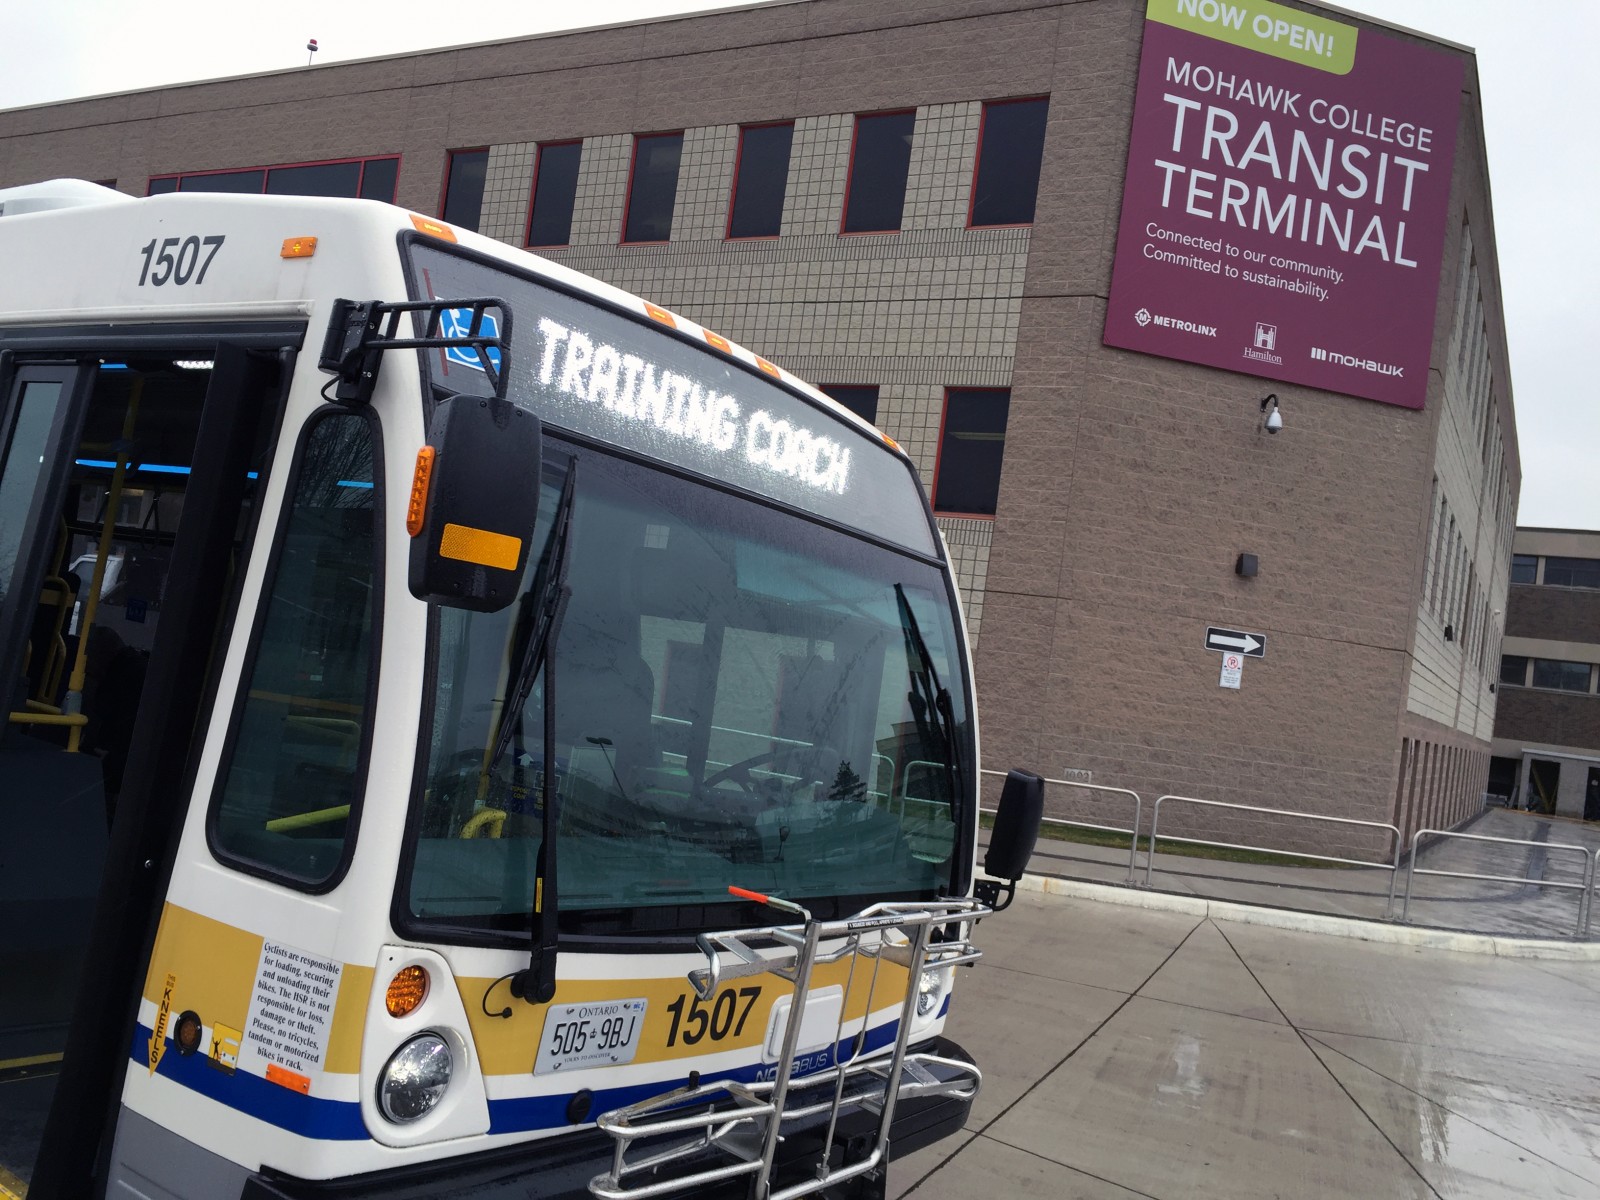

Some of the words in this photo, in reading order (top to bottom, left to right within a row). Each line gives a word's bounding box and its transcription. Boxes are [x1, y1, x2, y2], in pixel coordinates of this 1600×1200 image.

[1177, 0, 1247, 30] NOW
[1252, 15, 1334, 57] OPEN!
[1166, 57, 1302, 118] MOHAWK
[1309, 98, 1433, 153] COLLEGE
[1163, 93, 1429, 212] TRANSIT
[1154, 159, 1418, 268] TERMINAL
[138, 235, 225, 287] 1507
[1146, 222, 1222, 253] Connected
[1225, 243, 1240, 257] to
[1243, 250, 1266, 264] our
[1269, 256, 1344, 285] community.
[1143, 243, 1221, 274] Committed
[1225, 264, 1239, 278] to
[1242, 270, 1329, 301] sustainability.
[1153, 315, 1217, 337] METROLINX
[1244, 347, 1282, 363] Hamilton
[538, 316, 741, 451] TRAINING
[747, 408, 851, 495] COACH
[264, 942, 288, 957] Cyclists
[288, 952, 299, 961] are
[300, 955, 339, 974] responsible
[264, 956, 274, 965] for
[303, 970, 334, 988] securing
[257, 979, 276, 994] bikes.
[279, 986, 292, 999] The
[292, 992, 308, 1004] HSR
[309, 997, 316, 1007] is
[317, 1002, 330, 1012] not
[262, 970, 275, 979] and
[277, 975, 311, 994] unloading
[312, 985, 330, 998] their
[257, 994, 295, 1014] responsible
[296, 1006, 307, 1017] for
[260, 1007, 286, 1024] damage
[287, 1019, 295, 1027] or
[297, 1021, 316, 1035] theft.
[579, 1005, 619, 1019] ONTARIO
[666, 986, 762, 1048] 1507
[151, 987, 172, 1063] KNEELS
[252, 1017, 276, 1034] Please,
[277, 1029, 287, 1037] no
[288, 1031, 319, 1050] tricycles,
[551, 1020, 591, 1056] 505
[597, 1016, 636, 1050] 9BJ
[248, 1030, 273, 1046] tandem
[274, 1041, 282, 1050] or
[283, 1044, 320, 1063] motorized
[257, 1046, 275, 1060] bikes
[276, 1053, 284, 1064] in
[285, 1059, 303, 1071] rack.
